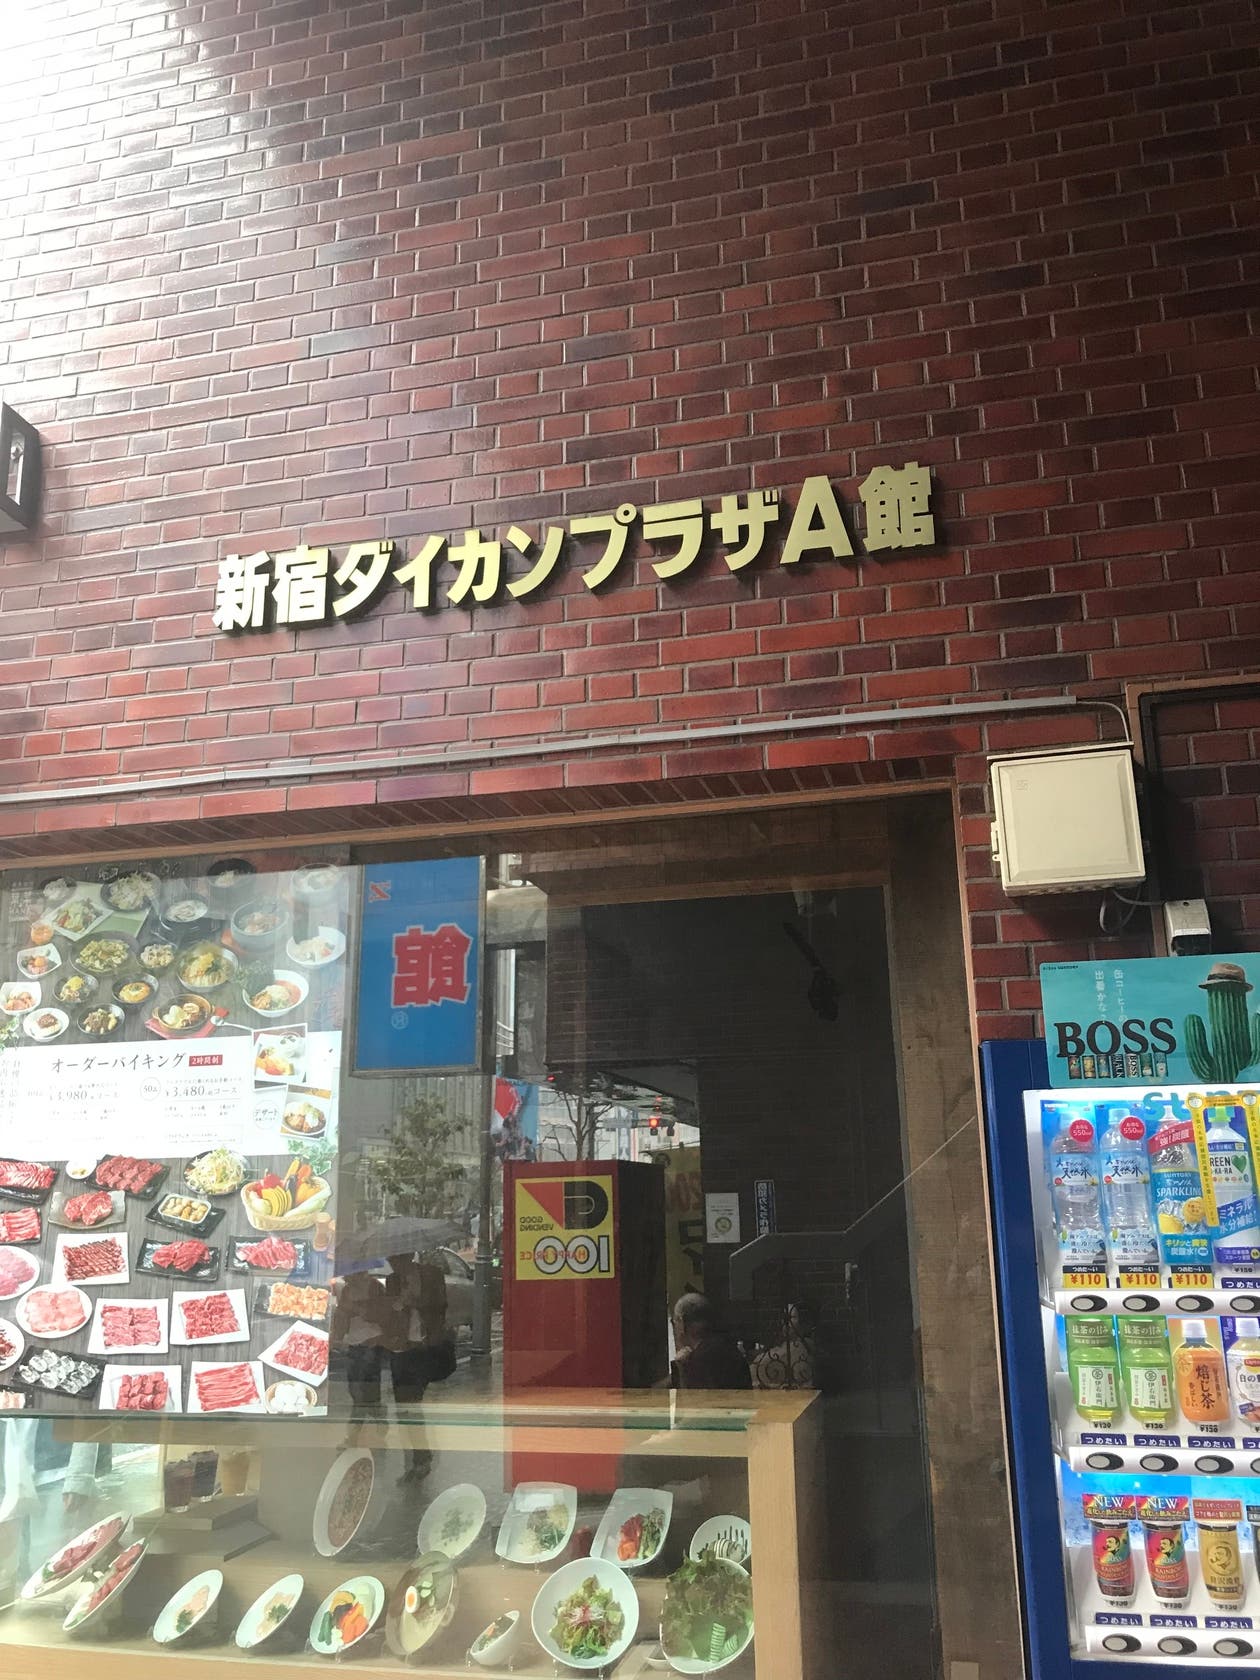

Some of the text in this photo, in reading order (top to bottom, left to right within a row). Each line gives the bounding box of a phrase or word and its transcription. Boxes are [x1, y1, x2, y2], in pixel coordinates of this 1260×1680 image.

[212, 462, 937, 632] 新宿ダイカンプラザA館
[1054, 1018, 1177, 1058] BOSS
[51, 1053, 186, 1073] オーダーバイキング
[1129, 1053, 1138, 1078] BOSS
[1209, 1156, 1231, 1167] REEN
[1061, 1166, 1092, 1179] 天然水
[1111, 1165, 1143, 1178] 天然水
[1071, 1274, 1101, 1285] ¥110
[1126, 1274, 1157, 1285] ¥110
[1176, 1274, 1208, 1286] ¥110
[1085, 1437, 1123, 1445] つめたい
[1139, 1438, 1178, 1446] つめたい
[1192, 1440, 1232, 1448] つめたい
[1093, 1496, 1125, 1507] NEW
[1147, 1498, 1179, 1509] NEW
[1100, 1616, 1139, 1625] つめたい
[1154, 1618, 1194, 1627] つめたい
[1208, 1620, 1249, 1629] つめたい
